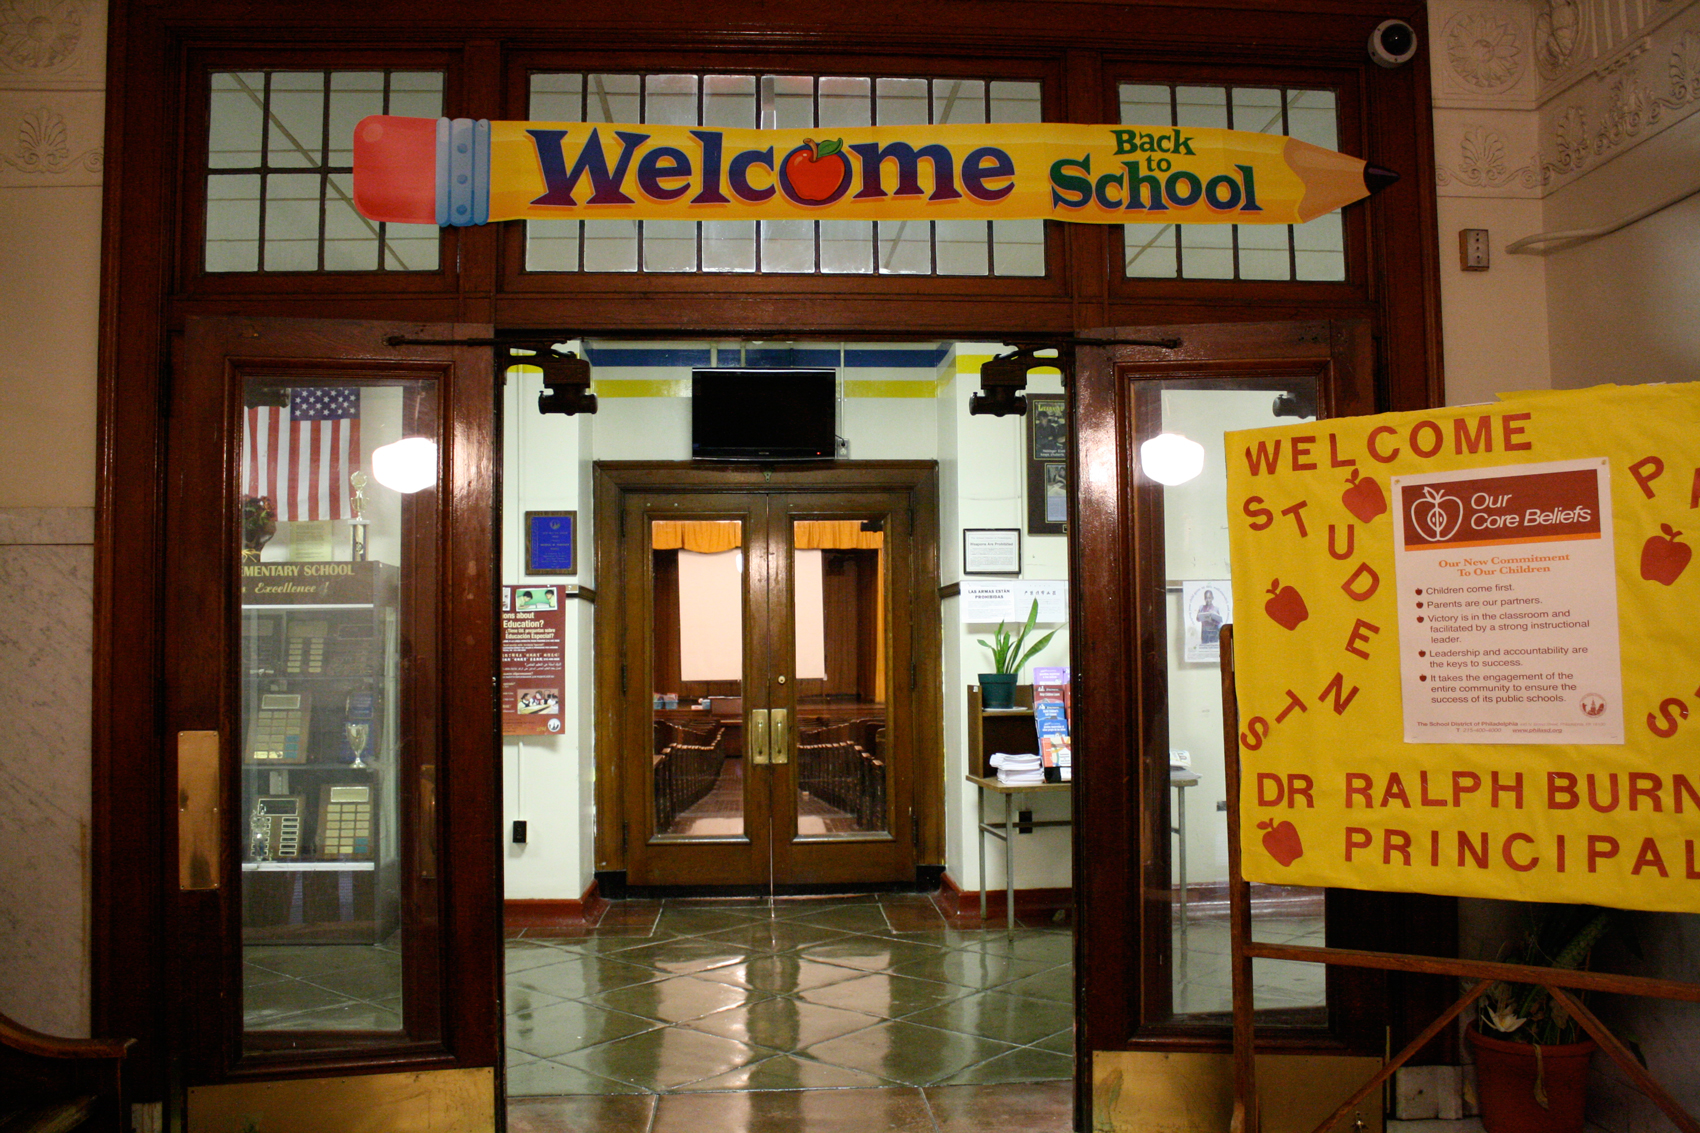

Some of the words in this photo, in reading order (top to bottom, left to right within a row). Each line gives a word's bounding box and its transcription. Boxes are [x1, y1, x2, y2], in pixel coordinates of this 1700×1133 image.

[1109, 128, 1197, 156] Back
[524, 127, 1016, 207] Welcome
[1145, 154, 1172, 172] to
[1049, 152, 1264, 211] School
[1245, 412, 1532, 477] WELCOME
[1471, 493, 1512, 510] Our
[1471, 512, 1519, 530] Core
[1524, 506, 1591, 526] Beliefs
[1438, 559, 1461, 568] Our
[1463, 558, 1489, 567] New
[1491, 554, 1570, 565] Commitment
[303, 564, 355, 576] SCHOOL
[1457, 569, 1471, 577] To
[1474, 568, 1496, 577] Our
[1499, 565, 1551, 574] Children
[255, 582, 316, 594] Excellence
[1426, 587, 1464, 595] Children
[1495, 584, 1515, 592] first.
[1427, 600, 1462, 609] Parents
[1482, 599, 1498, 607] our
[1500, 597, 1543, 608] partners.
[1428, 614, 1458, 624] Victory
[1471, 613, 1479, 621] in
[1499, 610, 1549, 620] classroom
[1551, 610, 1571, 618] and
[503, 620, 544, 628] Education?
[1430, 624, 1473, 633] facilitated
[1475, 624, 1487, 633] by
[1498, 622, 1528, 632] strong
[1531, 620, 1590, 630] instructional
[1431, 636, 1462, 644] leader.
[1429, 649, 1481, 659] Leadership
[1483, 648, 1500, 656] and
[1503, 646, 1569, 656] accountability
[1446, 660, 1468, 669] keys
[1430, 674, 1436, 682] It
[1438, 674, 1463, 682] takes
[1483, 673, 1543, 682] engagement
[1545, 672, 1555, 680] of
[1557, 672, 1574, 680] the
[1431, 685, 1456, 693] entire
[1459, 684, 1510, 694] community
[1513, 684, 1522, 692] to
[1561, 683, 1577, 691] the
[1431, 696, 1469, 704] success
[1471, 695, 1480, 703] of
[1482, 695, 1494, 703] its
[1496, 694, 1524, 704] public
[1526, 694, 1567, 703] schools.
[1256, 772, 1315, 808] DR
[1345, 770, 1523, 810] RALPH
[1345, 826, 1700, 880] PRINCIPAL
